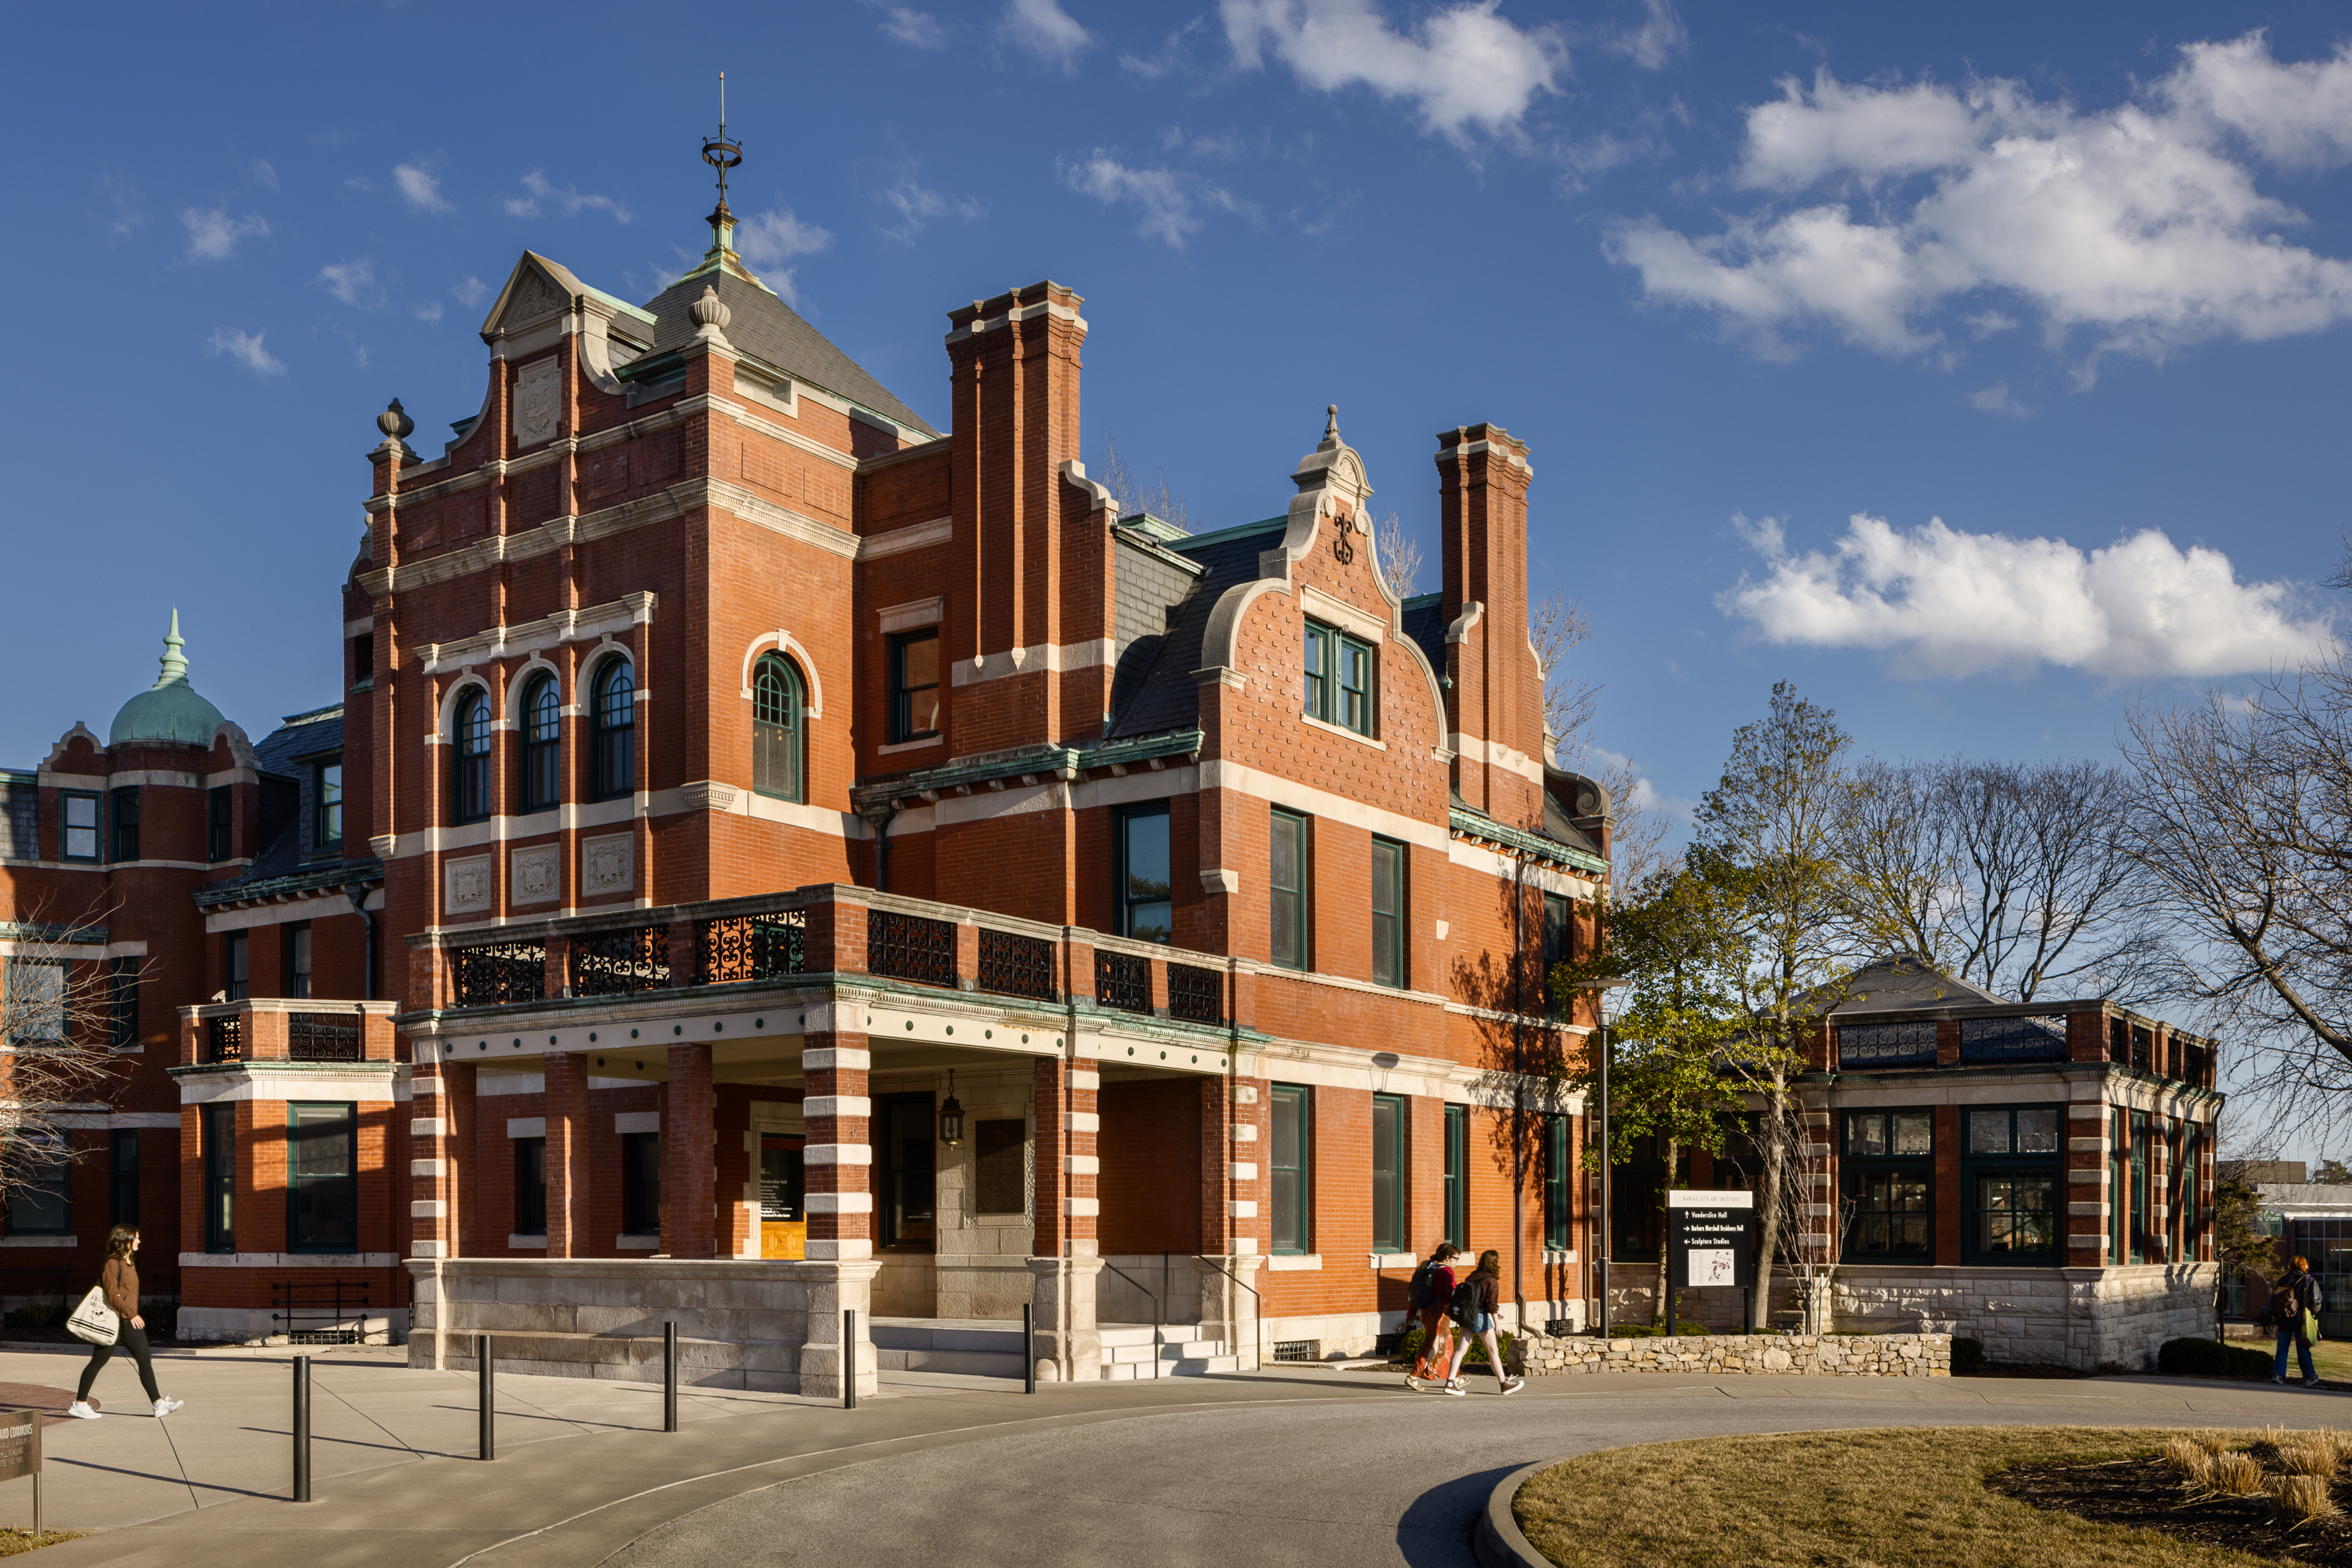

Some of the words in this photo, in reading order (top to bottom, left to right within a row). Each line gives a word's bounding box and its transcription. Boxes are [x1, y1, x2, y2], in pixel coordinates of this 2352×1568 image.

[526, 387, 549, 413] 1896
[1691, 1238, 1712, 1246] Sculpture
[10, 1423, 32, 1438] COMMONS
